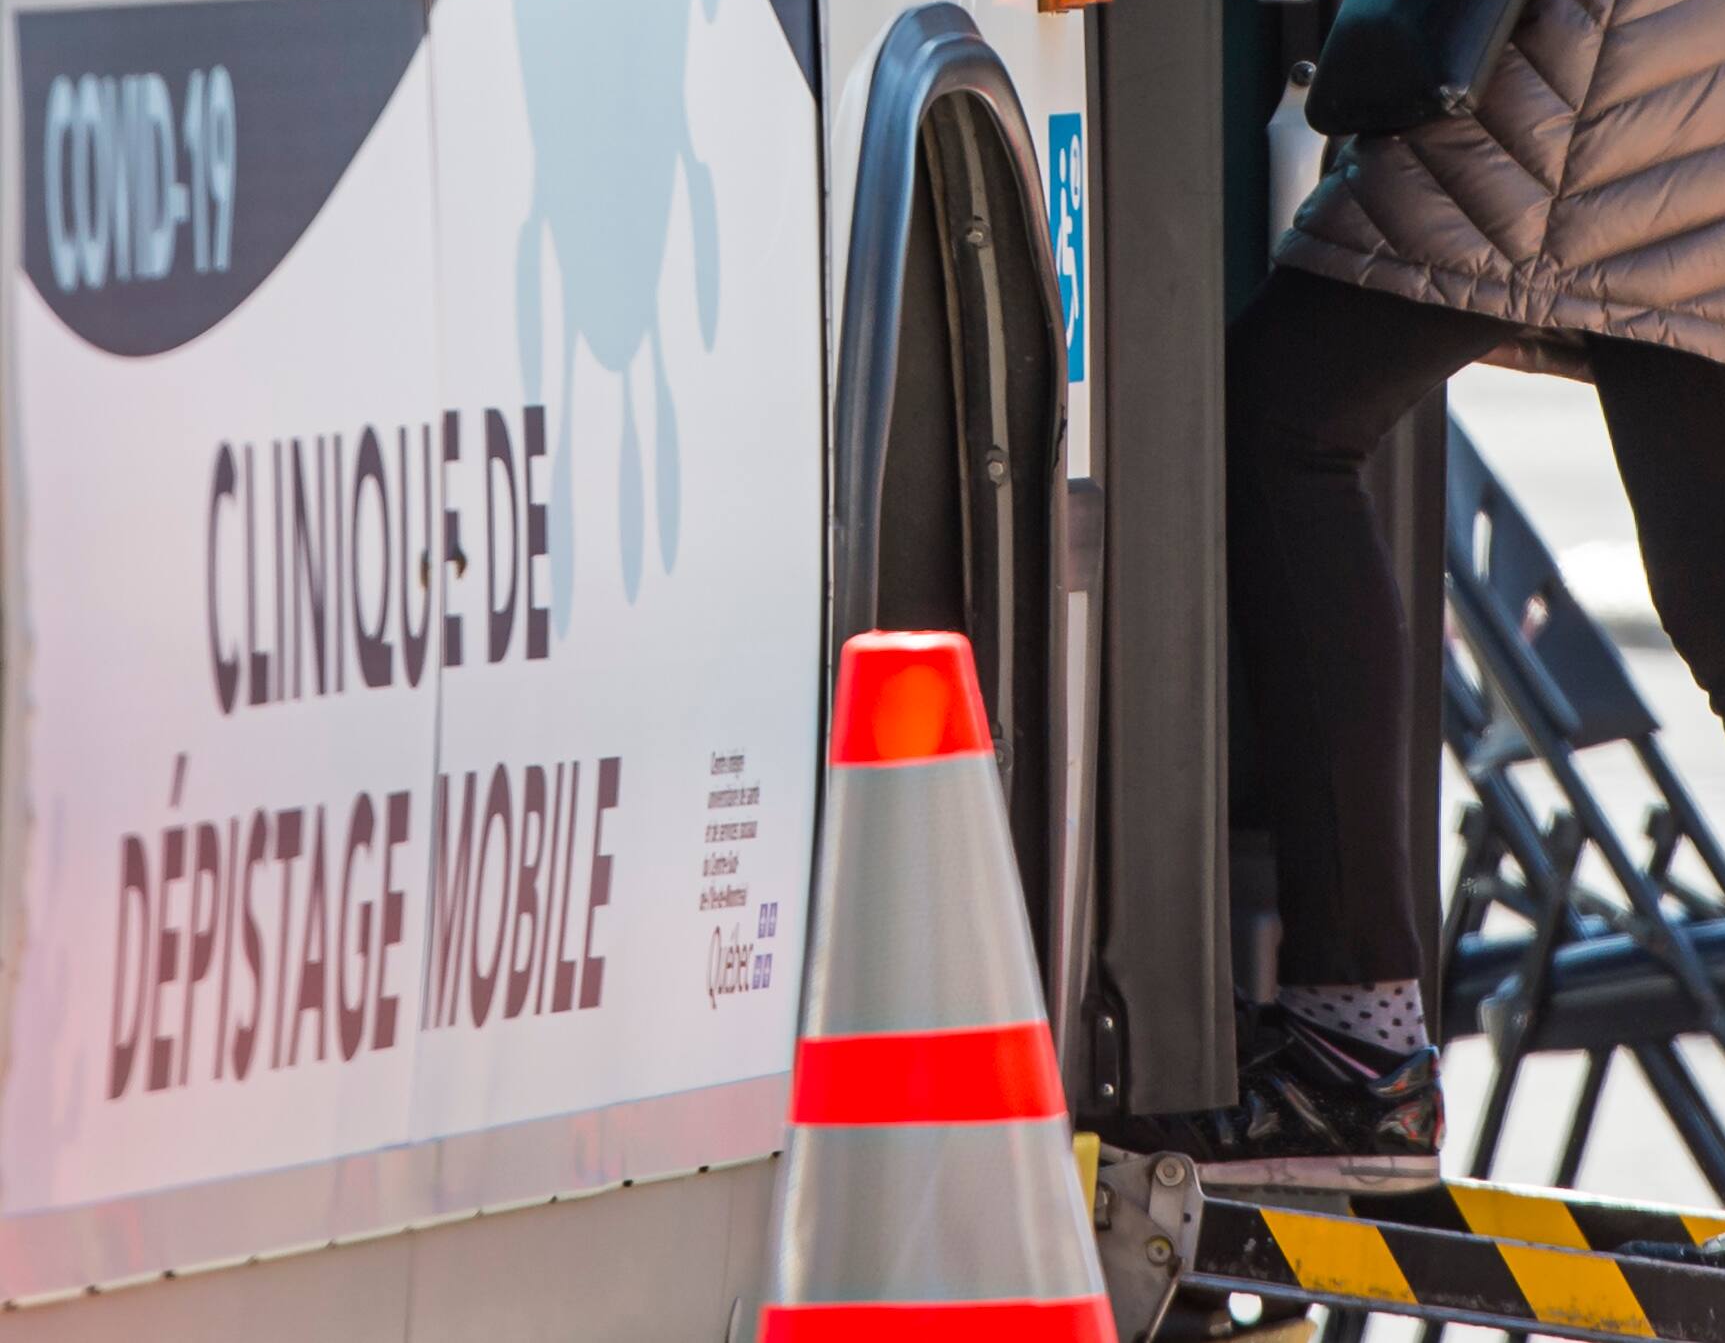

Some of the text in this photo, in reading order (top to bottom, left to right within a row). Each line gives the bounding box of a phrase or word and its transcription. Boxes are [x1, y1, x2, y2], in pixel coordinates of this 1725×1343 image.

[43, 64, 238, 294] COVID-19
[206, 404, 552, 716] CLINIQUE DE
[106, 752, 623, 1102] DÉPISTAGE MOBILE
